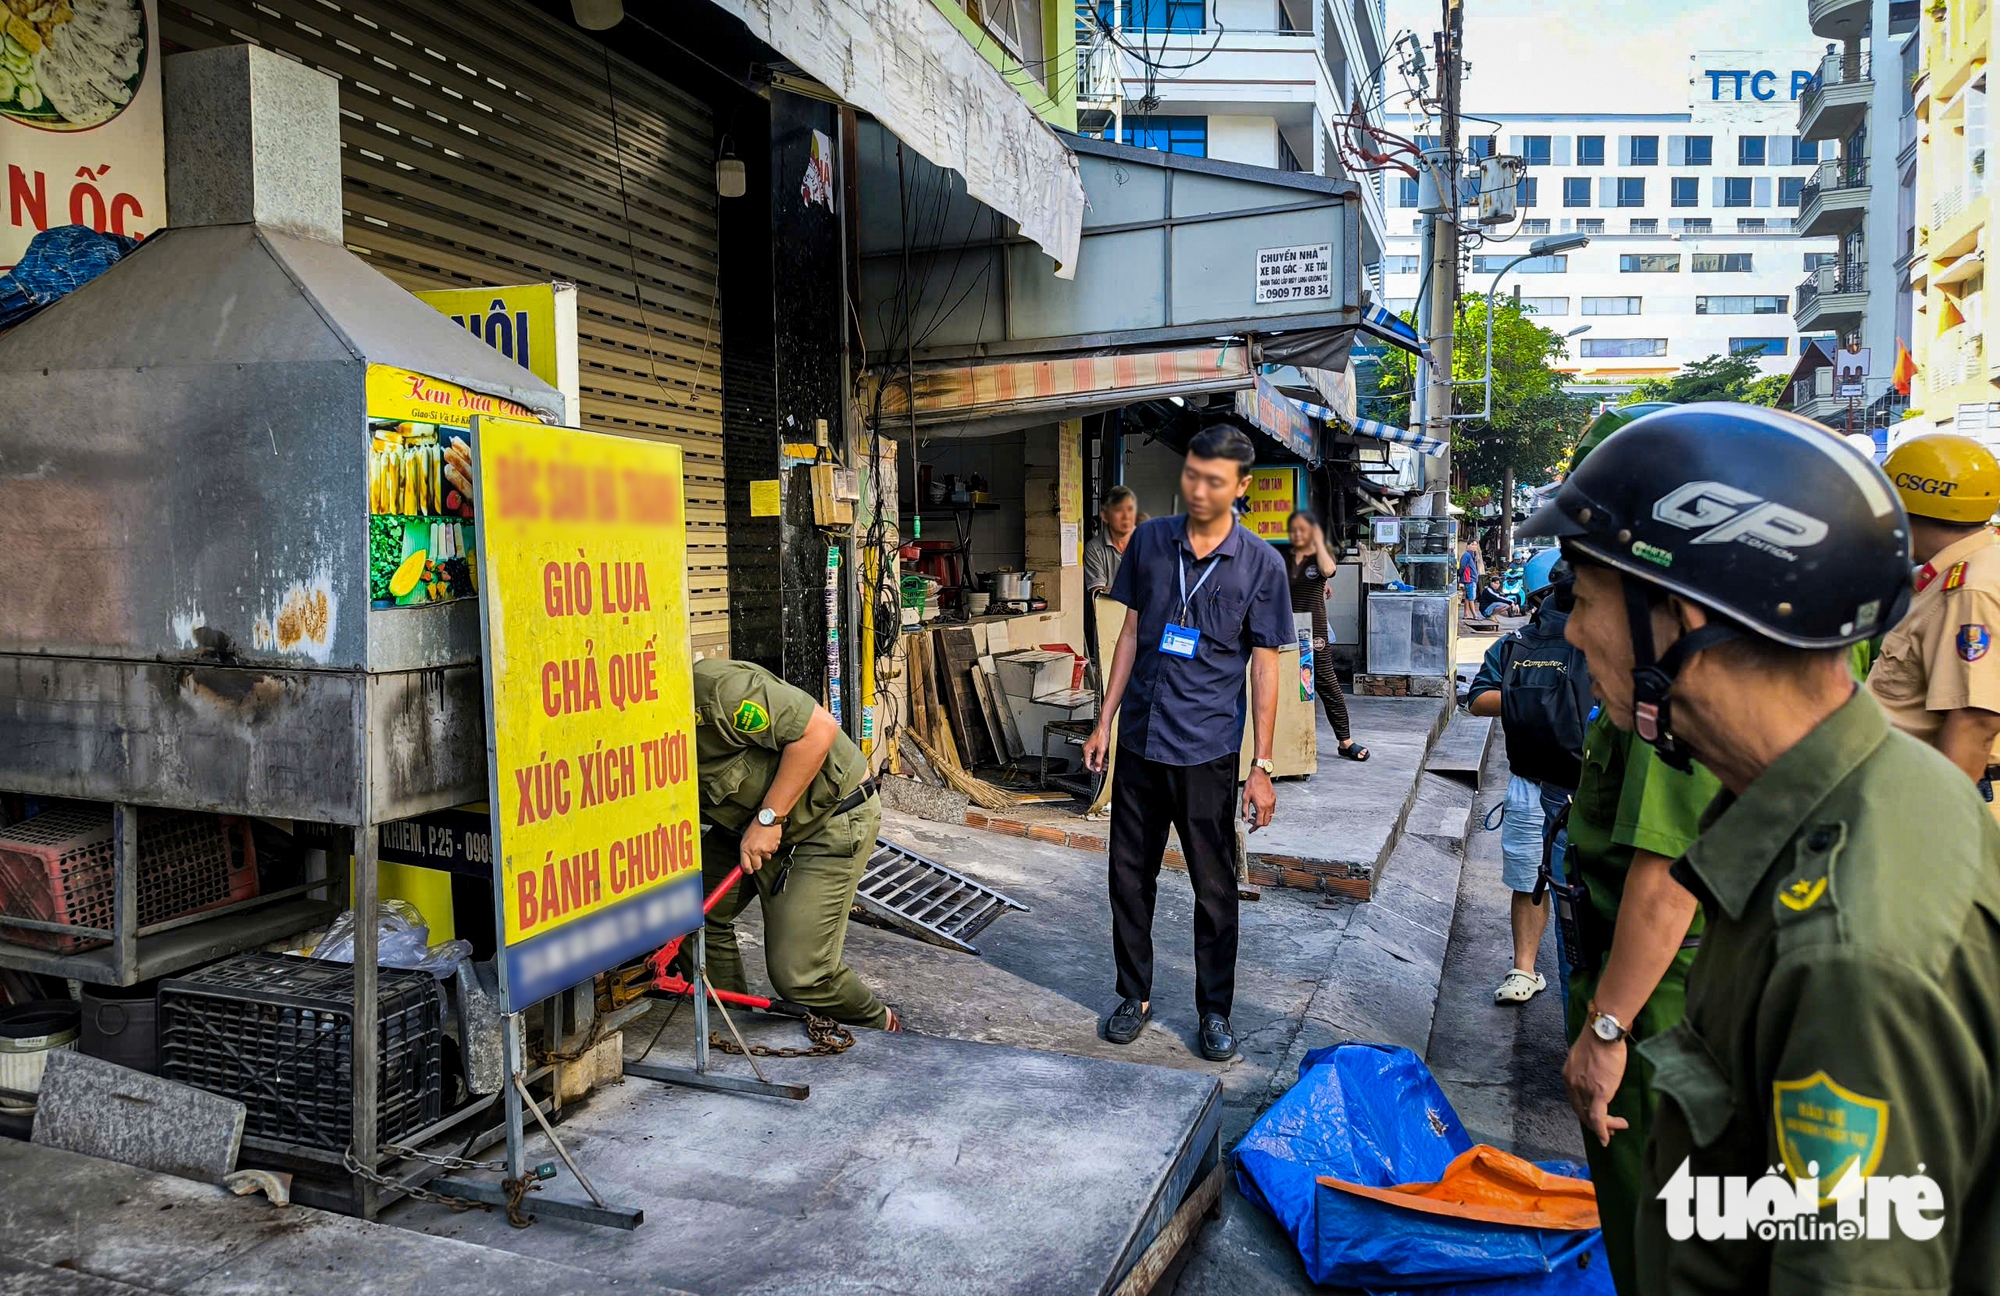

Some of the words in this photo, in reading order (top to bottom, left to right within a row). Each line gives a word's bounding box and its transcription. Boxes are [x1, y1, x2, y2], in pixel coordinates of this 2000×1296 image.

[1704, 69, 1777, 101] TTC
[69, 163, 146, 242] ỐC
[1260, 248, 1297, 264] CHUYỂN
[1299, 247, 1319, 260] NHÀ
[1260, 266, 1269, 276] XE
[1271, 265, 1280, 275] BA
[1282, 262, 1297, 274] GÁC
[1304, 262, 1314, 272] XE
[1265, 287, 1290, 299] 0909
[1292, 286, 1302, 297] 77
[1304, 285, 1316, 296] 88
[1317, 284, 1329, 295] 34
[402, 375, 451, 406] Kem
[1894, 472, 1959, 497] CSGT
[543, 548, 593, 618] GIÒ
[600, 562, 651, 625] LỤA
[541, 638, 602, 717] CHẢ
[608, 634, 659, 712] QUẾ
[515, 751, 571, 827] XÚC
[578, 739, 636, 810] XÍCH
[640, 729, 689, 792] TƯƠI
[428, 825, 454, 858] P.25
[517, 850, 601, 932] BÁNH
[609, 819, 694, 895] CHƯNG
